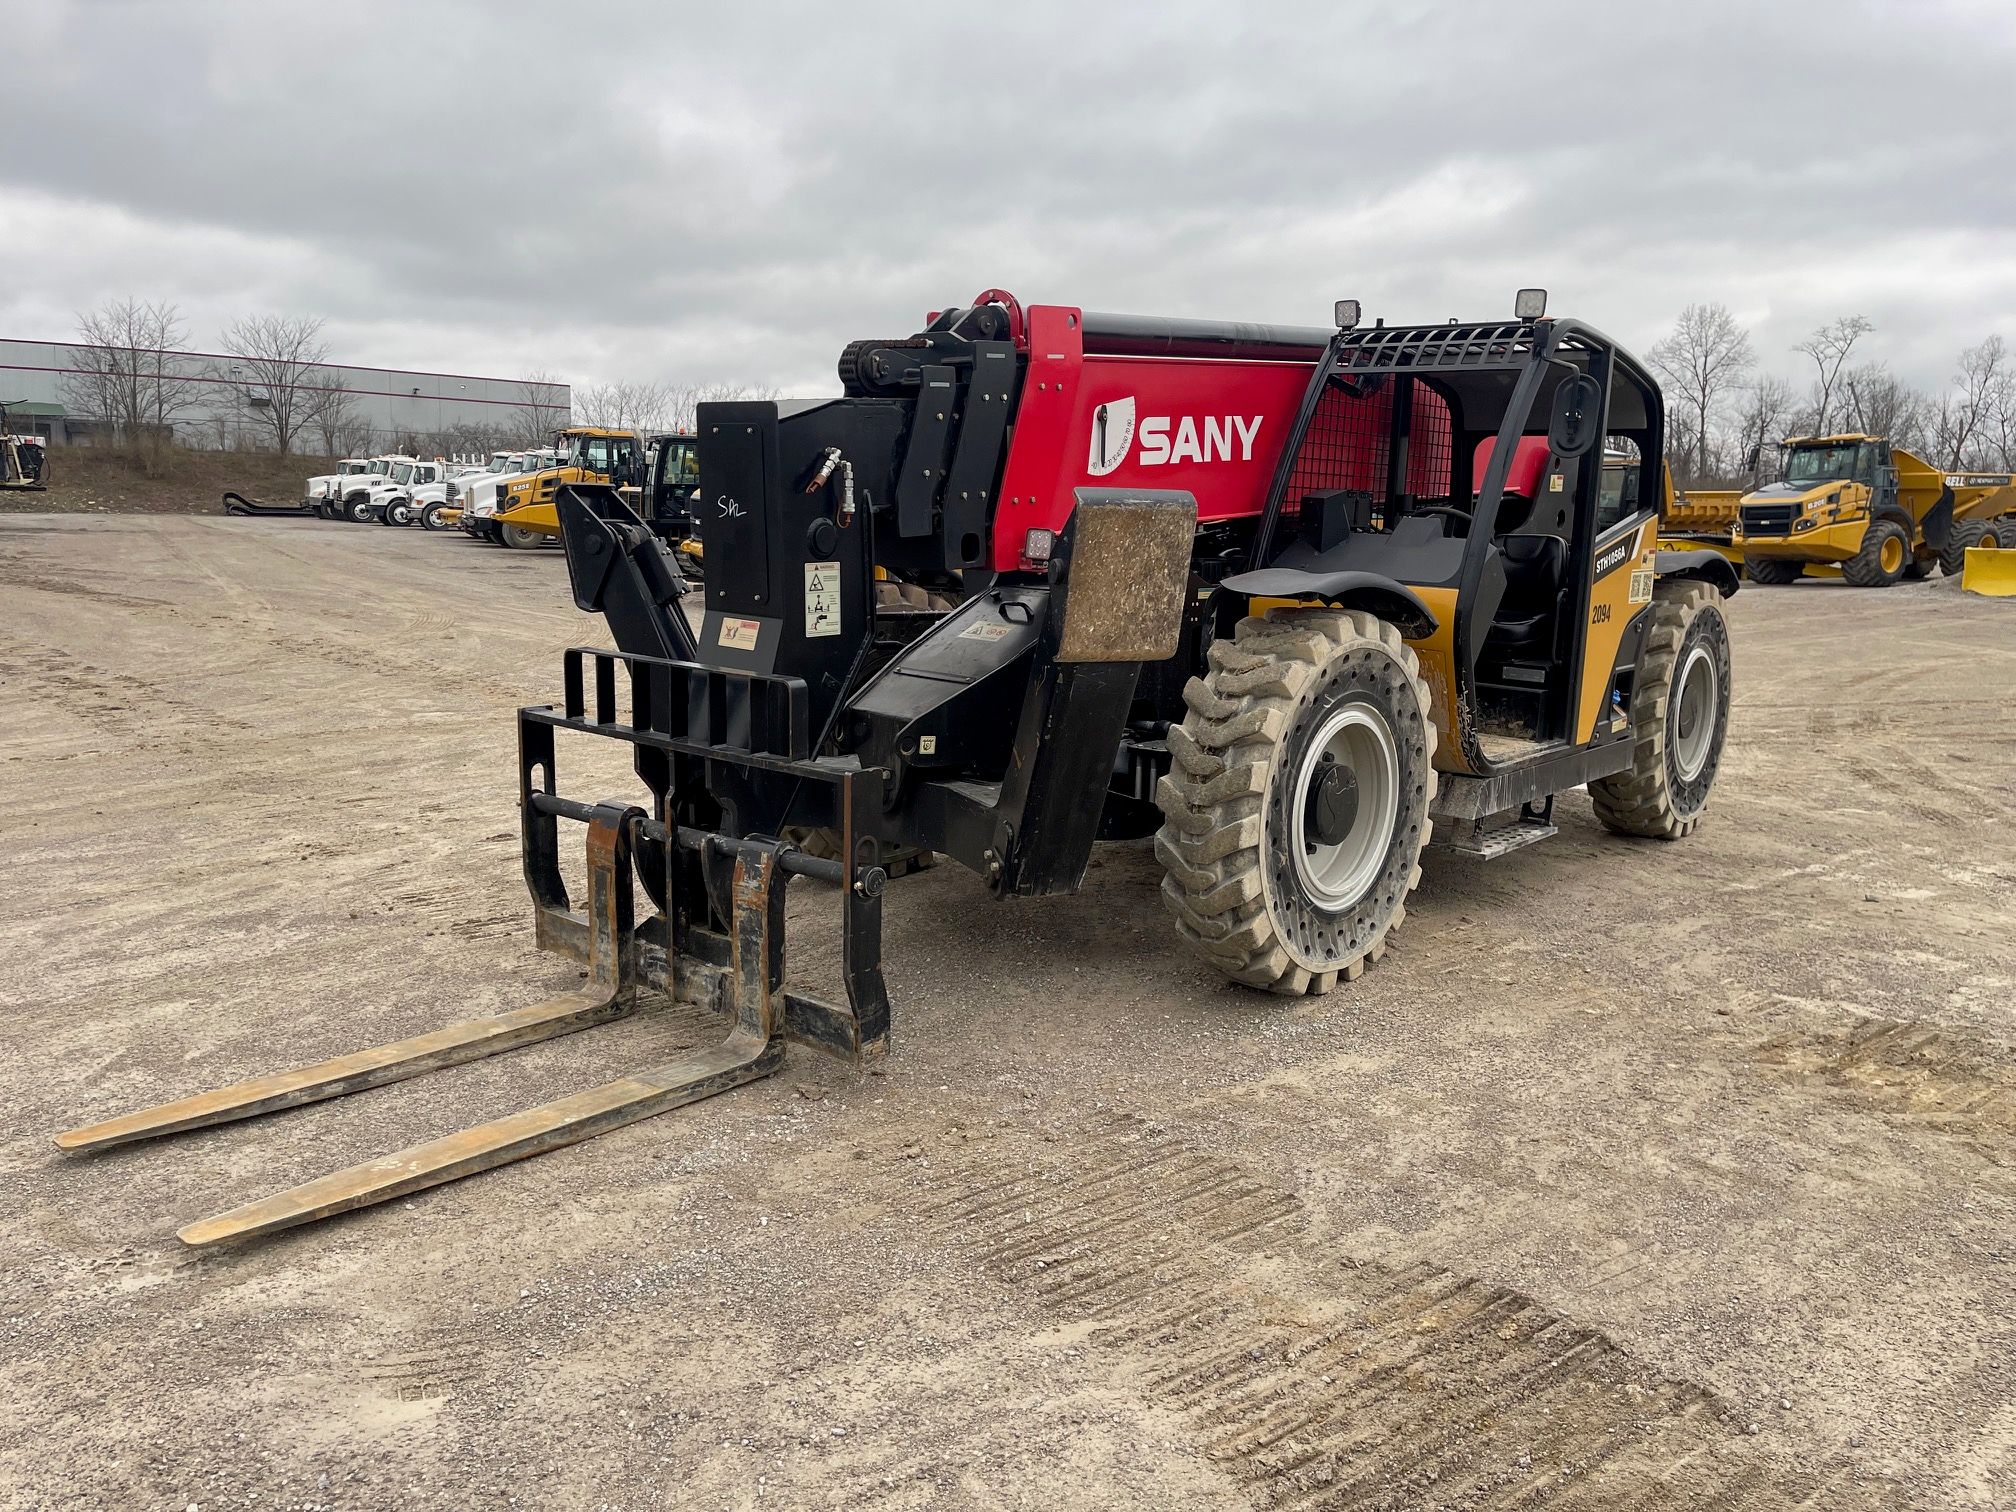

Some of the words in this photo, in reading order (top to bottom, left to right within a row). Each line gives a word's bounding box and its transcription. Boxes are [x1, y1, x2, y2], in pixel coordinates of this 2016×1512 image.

[1139, 415, 1264, 466] SANY
[1945, 476, 1965, 487] BELL
[1596, 545, 1626, 573] STH1056A
[1592, 604, 1611, 624] 2094
